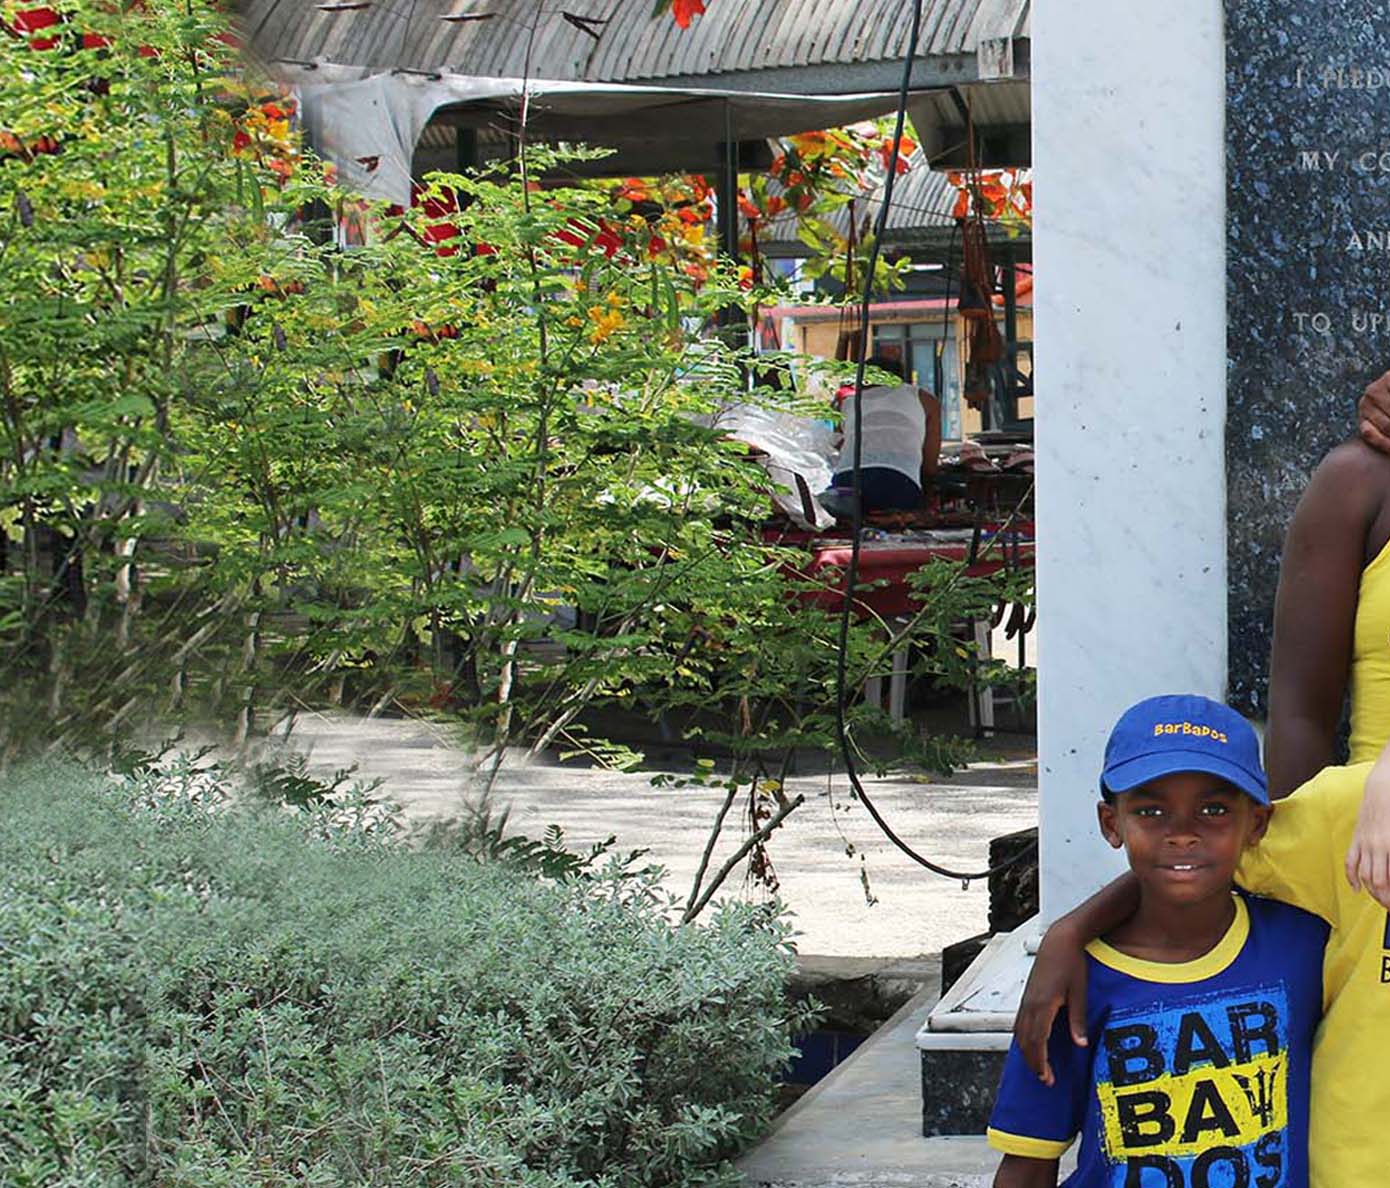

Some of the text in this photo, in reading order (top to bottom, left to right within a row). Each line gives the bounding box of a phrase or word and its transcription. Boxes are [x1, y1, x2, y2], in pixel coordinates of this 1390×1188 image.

[1300, 152, 1340, 172] MY
[1294, 312, 1332, 333] TO
[1105, 1001, 1279, 1088] BAR
[1124, 1131, 1283, 1188] DOS
